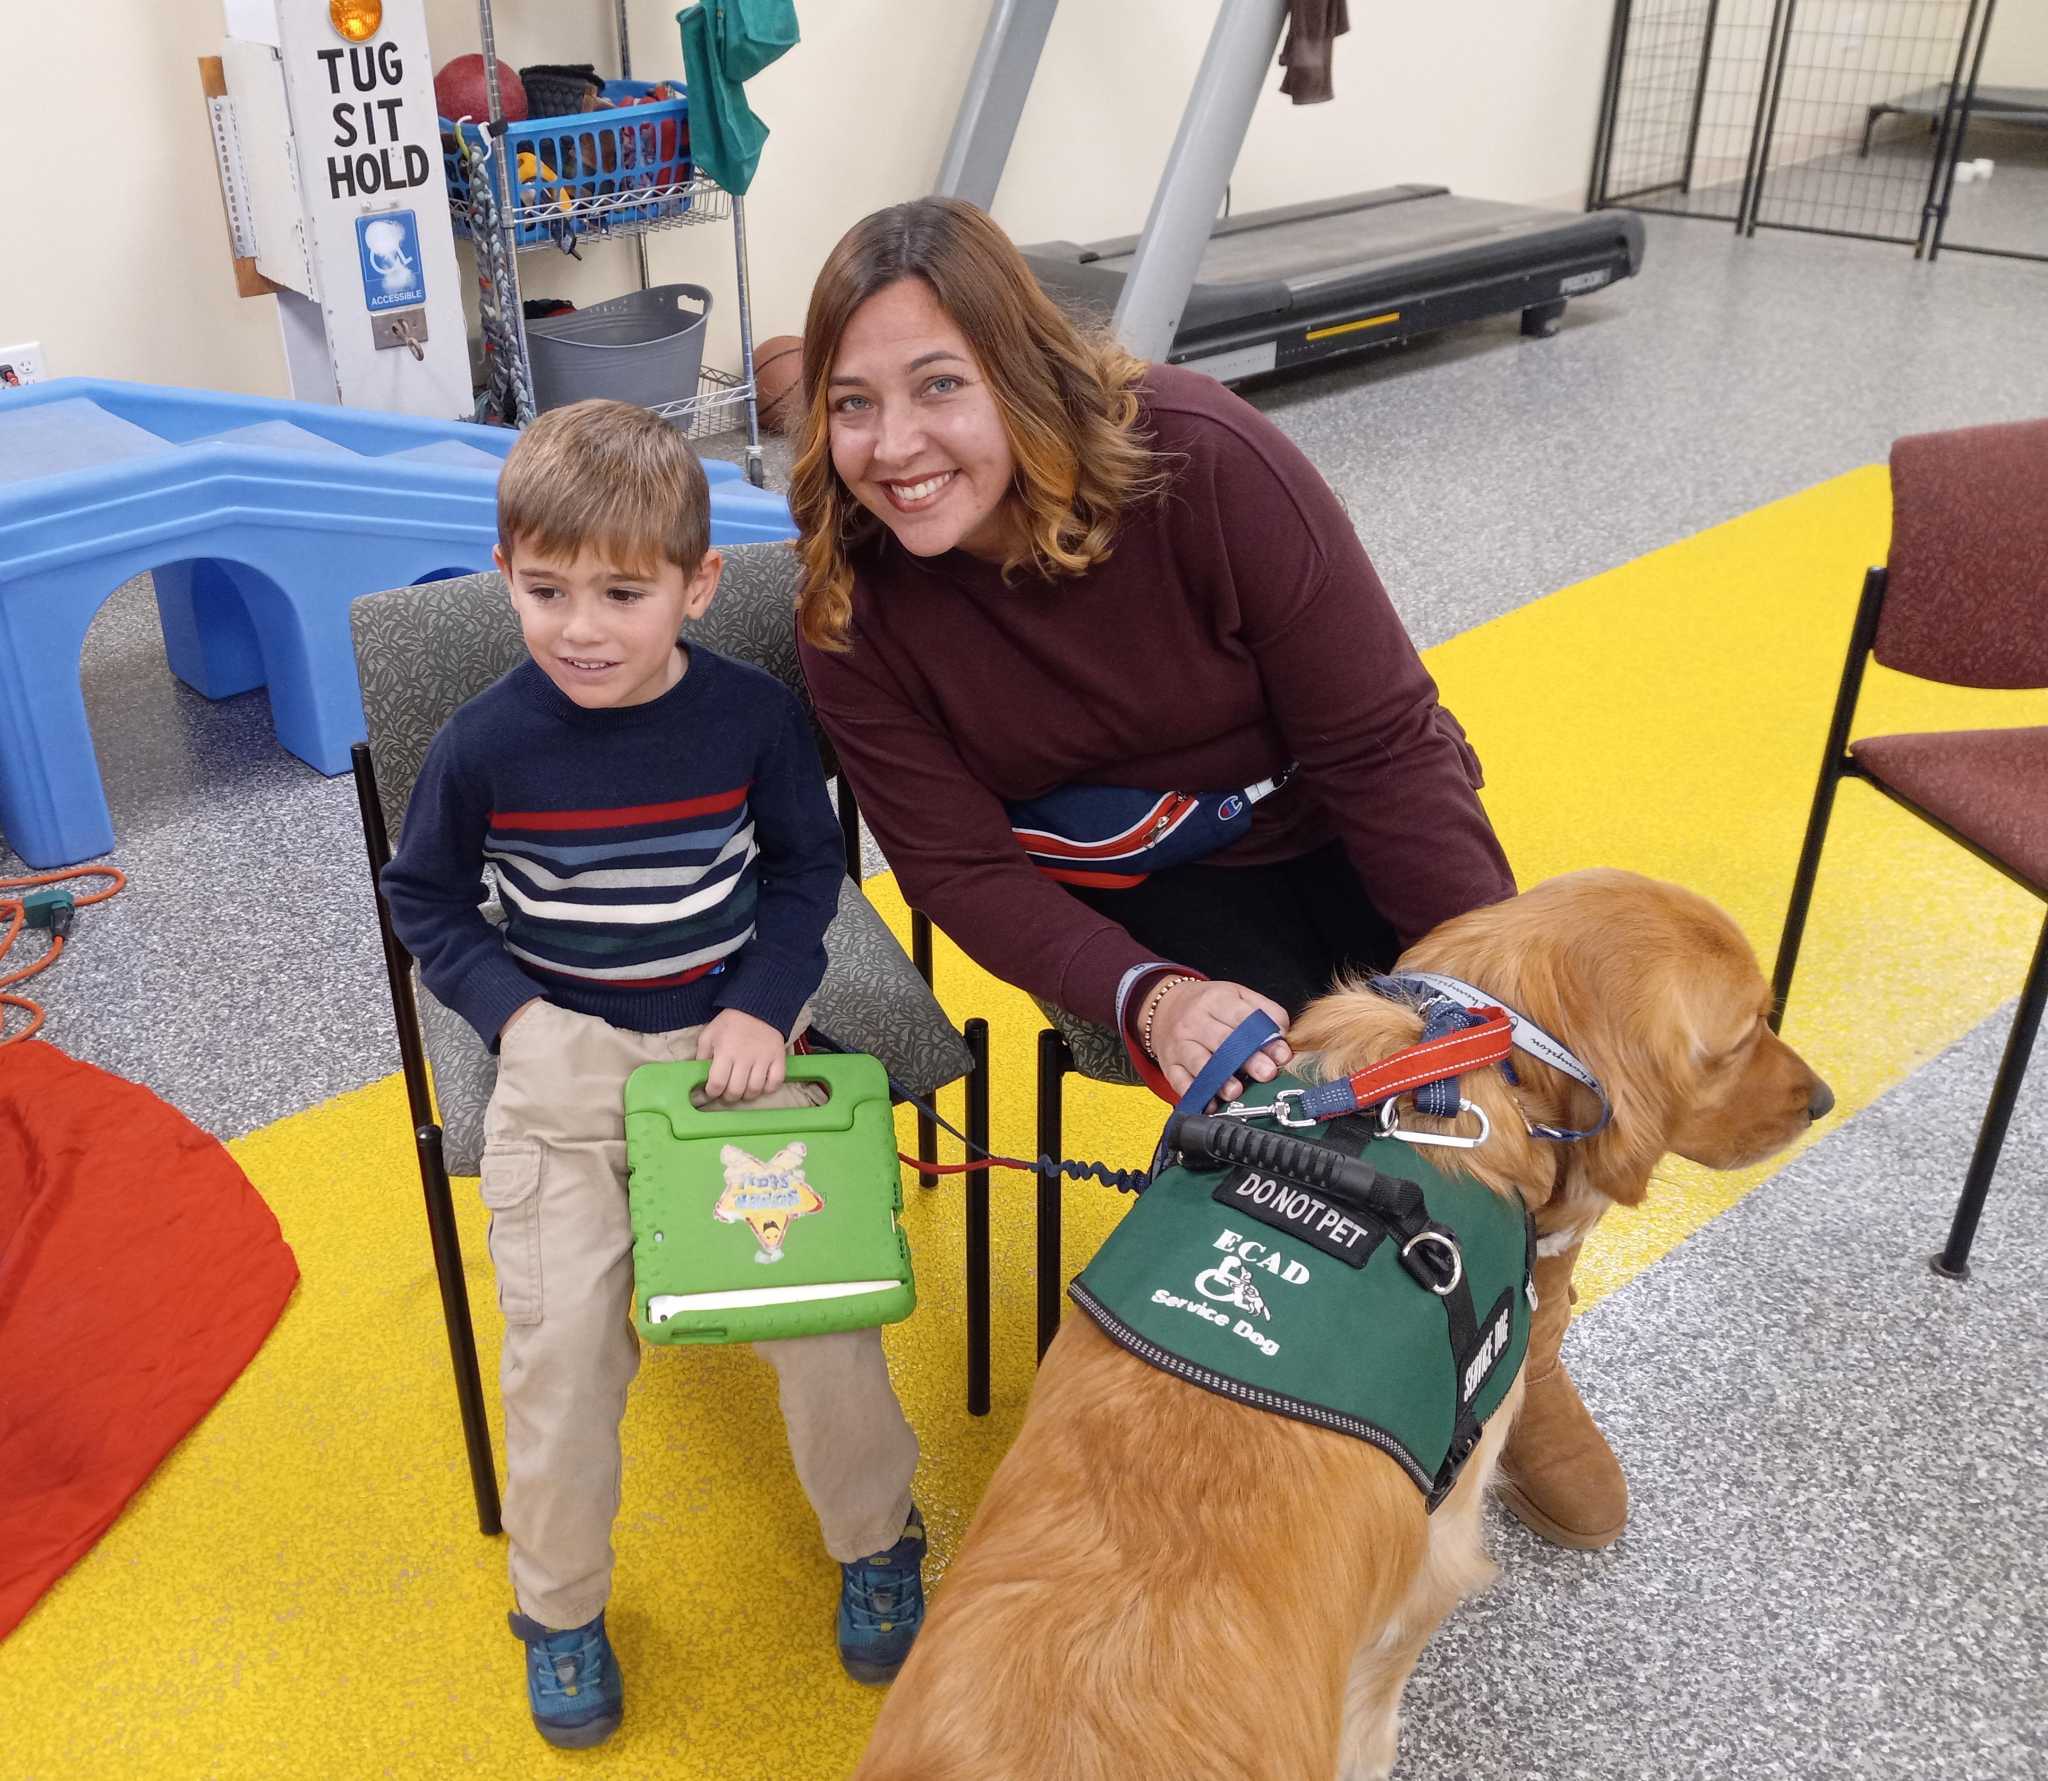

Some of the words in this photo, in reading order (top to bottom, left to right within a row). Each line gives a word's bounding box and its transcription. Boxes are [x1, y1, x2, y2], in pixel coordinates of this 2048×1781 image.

[317, 41, 403, 94] TUG
[333, 98, 403, 147] SIT
[327, 144, 430, 199] HOLD
[370, 289, 422, 306] ACCESSIBLE
[1235, 1172, 1274, 1204] DO
[1269, 1186, 1326, 1225] NOT
[1316, 1207, 1369, 1249] PET
[1212, 1228, 1310, 1285] ECAD
[1151, 1289, 1230, 1327] Service
[1232, 1319, 1281, 1357] Dog
